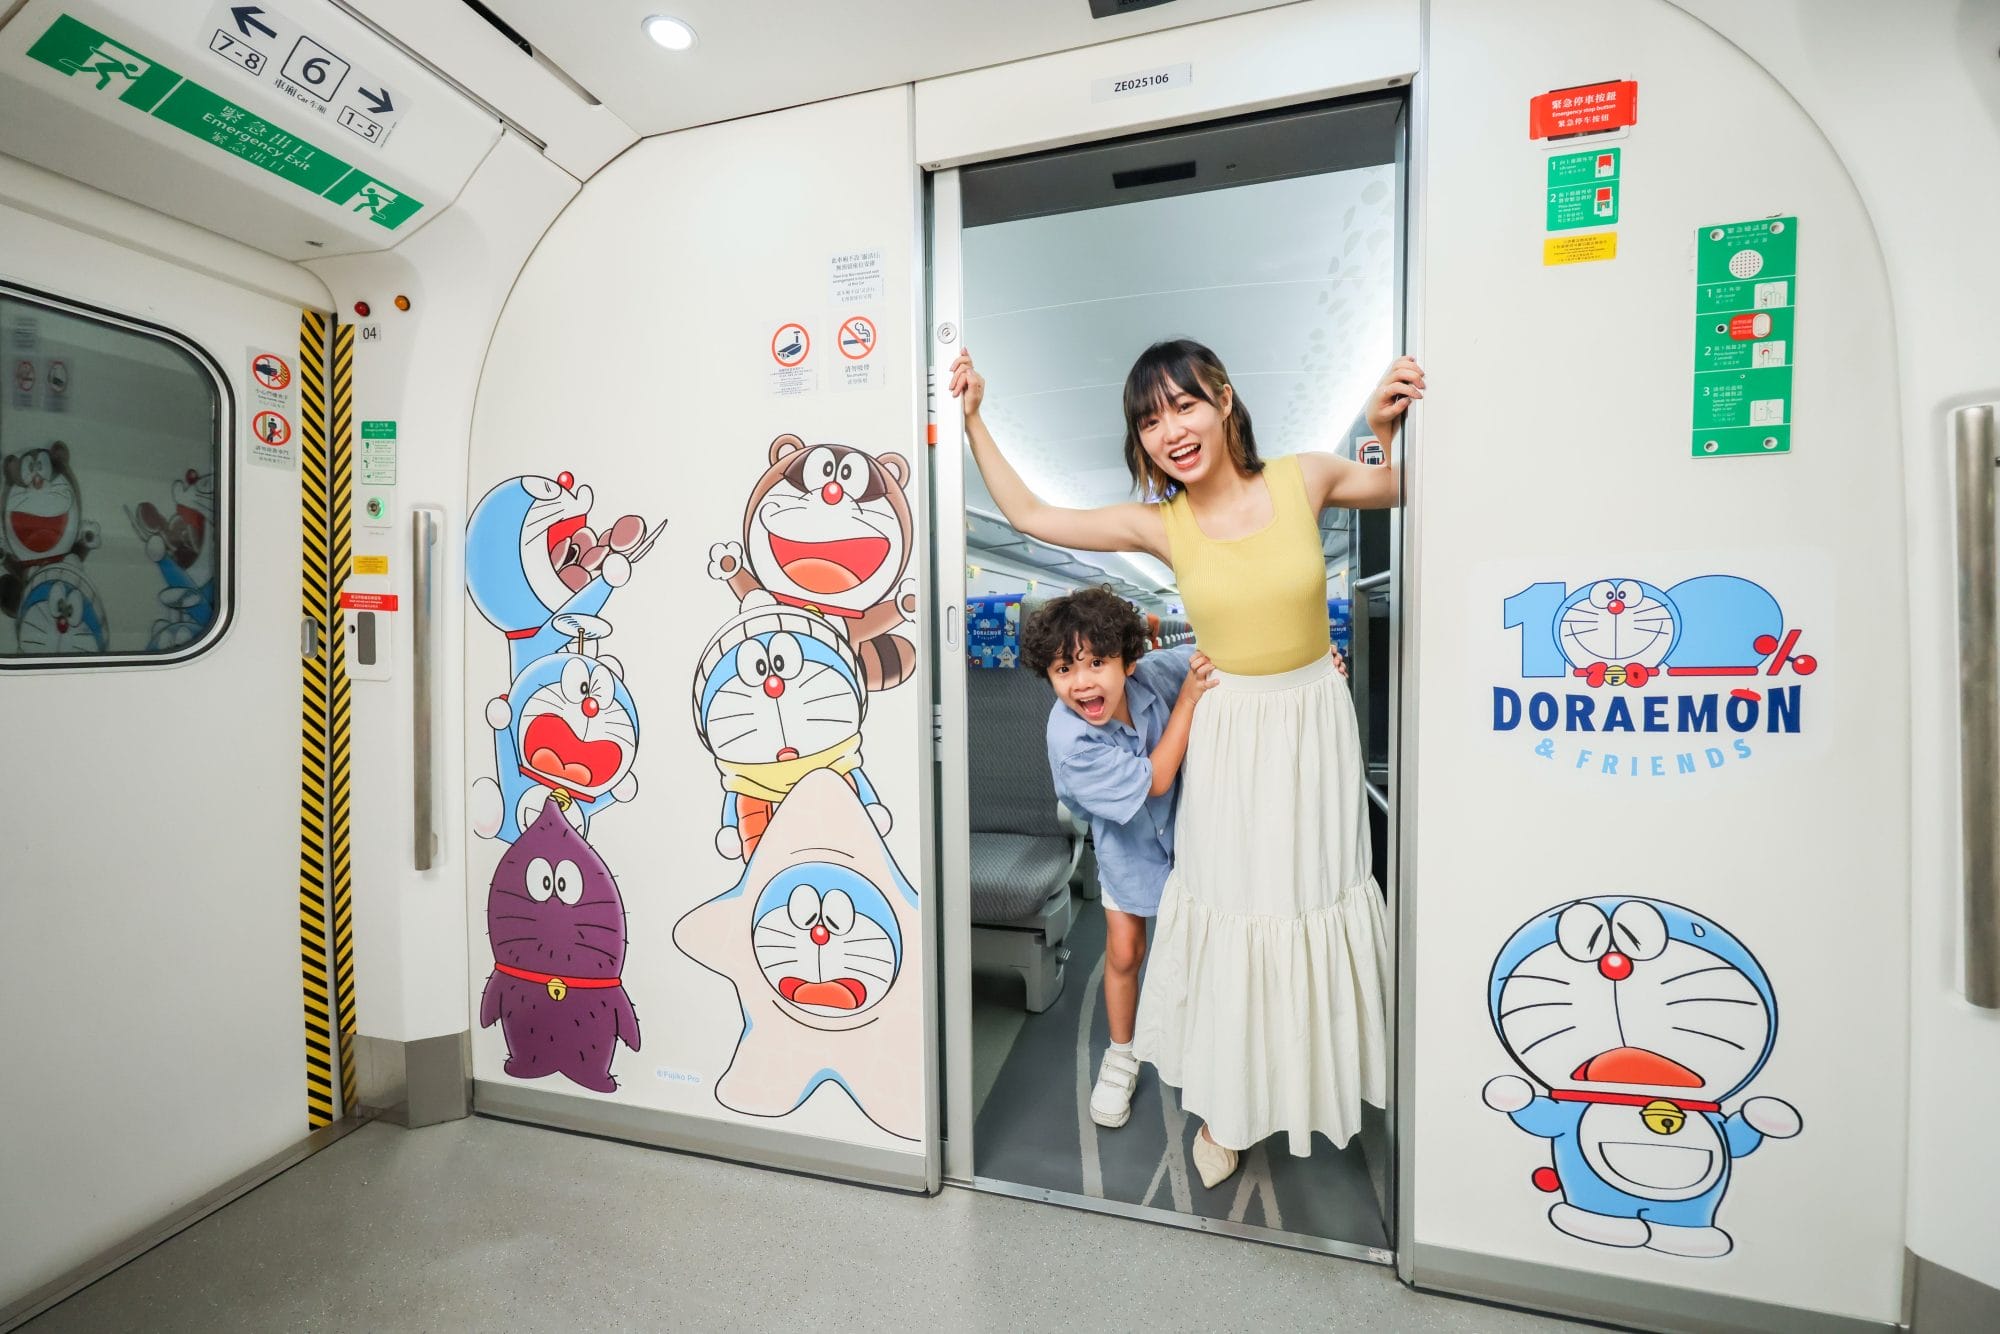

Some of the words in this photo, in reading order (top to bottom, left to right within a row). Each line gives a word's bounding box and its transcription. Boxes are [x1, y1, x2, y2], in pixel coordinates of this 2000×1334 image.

[218, 35, 261, 70] 7-8
[302, 58, 331, 85] 6
[1114, 73, 1169, 92] ZE025106
[1552, 108, 1583, 118] Emergency
[1596, 103, 1617, 111] button
[220, 105, 316, 161] 緊急出口
[346, 112, 378, 138] 1-5
[202, 112, 284, 158] Emergency
[284, 153, 311, 171] Exit
[1551, 161, 1556, 171] 1
[1549, 193, 1557, 203] 2
[1707, 288, 1712, 298] 1
[362, 326, 377, 340] 04
[1704, 345, 1712, 356] 2
[1703, 386, 1710, 396] 3
[1493, 684, 1802, 733] DORAEMON
[1534, 737, 1555, 760] &
[1576, 738, 1752, 776] FRIENDS
[687, 1074, 700, 1082] Pro
